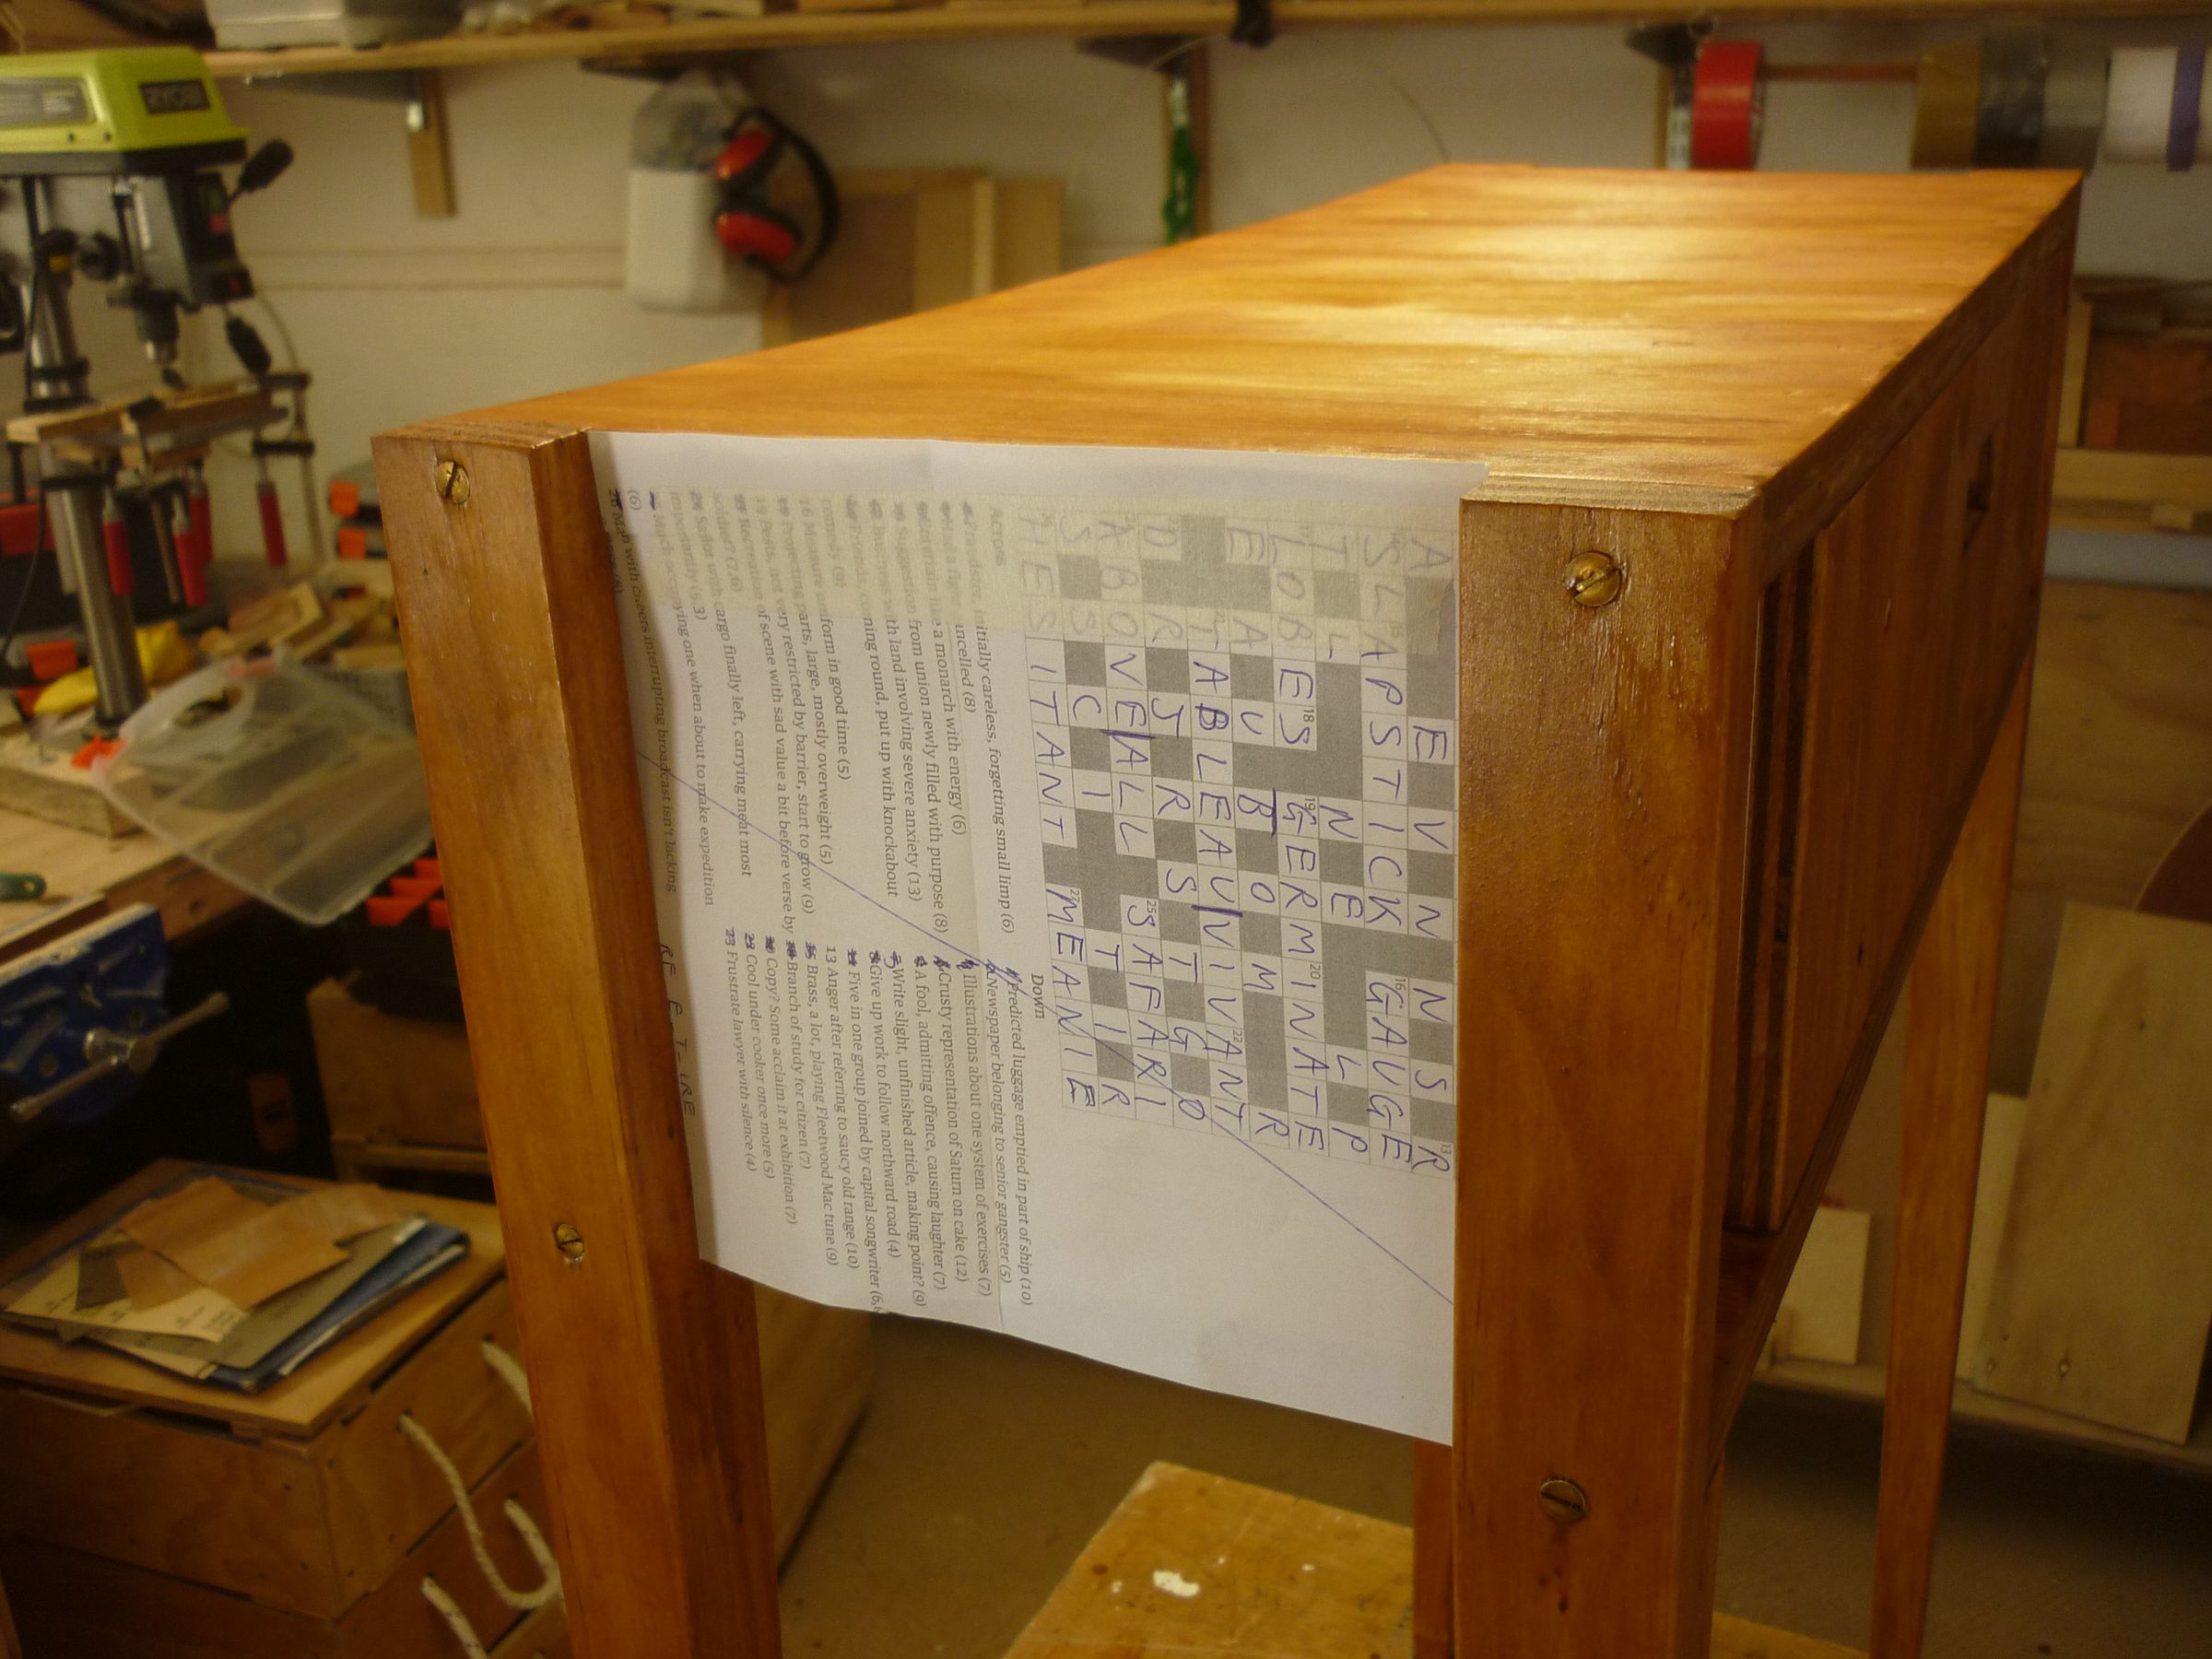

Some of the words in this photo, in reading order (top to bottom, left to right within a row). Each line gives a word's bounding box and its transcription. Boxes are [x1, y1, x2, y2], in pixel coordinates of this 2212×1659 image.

[683, 640, 697, 667] one
[759, 623, 779, 665] scene
[889, 640, 906, 673] land
[909, 619, 925, 656] from
[723, 644, 743, 692] finally
[770, 670, 784, 702] with
[783, 635, 805, 706] restricted
[806, 649, 821, 690] large,
[870, 655, 889, 705] round,
[914, 661, 930, 705] union
[935, 643, 956, 712] monarch
[689, 672, 702, 712] when
[732, 697, 747, 725] left,
[828, 677, 847, 713] good
[962, 692, 976, 712] (8)
[982, 676, 998, 743] careless,
[773, 708, 785, 733] sad
[813, 695, 829, 748] mostly
[876, 711, 891, 737] put
[894, 677, 913, 750] involving
[693, 716, 707, 759] about
[837, 719, 850, 755] time
[923, 711, 938, 759] newly
[946, 718, 960, 751] with
[733, 731, 748, 794] carrying
[776, 737, 788, 780] value
[796, 735, 811, 789] barrier,
[838, 759, 852, 780] (5)
[817, 753, 831, 840] overweight
[882, 767, 895, 801] with
[903, 754, 916, 806] severe
[925, 761, 941, 802] filled
[948, 757, 964, 810] energy
[988, 747, 1006, 825] forgetting
[698, 783, 711, 823] make
[737, 798, 749, 834] meat
[779, 795, 791, 816] bit
[798, 794, 810, 829] start
[780, 820, 795, 868] before
[905, 809, 921, 868] anxiety
[928, 807, 943, 842] with
[951, 815, 967, 835] (6)
[663, 841, 677, 892] lacking
[700, 827, 716, 905] expedition
[740, 841, 753, 877] most
[818, 844, 833, 865] (5)
[884, 806, 900, 897] knockabout
[995, 829, 1010, 870] small
[798, 853, 814, 890] grow
[907, 872, 923, 901] (13)
[928, 847, 946, 909] purpose
[998, 875, 1012, 909] limp
[782, 873, 794, 912] verse
[801, 894, 815, 913] (9)
[933, 913, 948, 933] (8)
[1001, 913, 1015, 934] (6)
[747, 954, 759, 986] Cool
[826, 946, 837, 963] 13
[727, 950, 742, 1016] Frustrate
[765, 958, 780, 1002] Copy?
[787, 960, 800, 1012] Branch
[806, 964, 818, 1007] Brass,
[827, 967, 840, 1011] Anger
[848, 971, 860, 1002] Five
[870, 965, 883, 997] Give
[891, 968, 906, 1007] Write
[937, 971, 952, 1020] Crusty
[1031, 973, 1045, 1018] Down
[748, 990, 761, 1032] under
[915, 985, 929, 1017] fool,
[964, 973, 980, 1062] Illustrations
[986, 977, 1002, 1059] Newspaper
[1007, 982, 1025, 1050] Predicted
[732, 1019, 747, 1066] lawyer
[770, 1005, 782, 1045] Some
[811, 1023, 823, 1047] lot,
[831, 1014, 843, 1048] after
[853, 1024, 864, 1051] one
[875, 1024, 888, 1060] work
[895, 1011, 910, 1054] slight,
[751, 1036, 766, 1084] cooker
[791, 1033, 806, 1073] study
[919, 1021, 935, 1092] admitting
[739, 1069, 751, 1100] with
[772, 1048, 787, 1100] acclaim
[795, 1077, 806, 1098] for
[810, 1051, 827, 1102] playing
[831, 1052, 847, 1113] referring
[852, 1053, 867, 1096] group
[941, 1024, 959, 1128] representation
[969, 1066, 982, 1107] about
[1011, 1053, 1028, 1111] luggage
[758, 1088, 770, 1119] once
[878, 1082, 892, 1125] follow
[899, 1060, 916, 1135] unfinished
[991, 1062, 1006, 1134] belonging
[741, 1103, 755, 1150] silence
[760, 1122, 771, 1158] more
[795, 1100, 809, 1147] citizen
[855, 1099, 870, 1143] joined
[924, 1095, 936, 1151] offence,
[971, 1112, 983, 1138] one
[745, 1153, 757, 1171] (4)
[799, 1150, 811, 1169] (7)
[816, 1106, 833, 1179] Fleetwood
[839, 1134, 851, 1173] saucy
[903, 1139, 920, 1186] article,
[1014, 1114, 1029, 1175] emptied
[763, 1160, 775, 1179] (5)
[780, 1135, 796, 1203] exhibition
[881, 1129, 897, 1202] northward
[926, 1156, 941, 1208] causing
[949, 1150, 964, 1195] Saturn
[971, 1141, 987, 1190] system
[996, 1155, 1008, 1200] senior
[822, 1182, 834, 1211] Mac
[842, 1177, 854, 1197] old
[861, 1166, 877, 1212] capital
[785, 1206, 797, 1224] (7)
[824, 1214, 837, 1244] tune
[843, 1202, 856, 1239] range
[887, 1206, 900, 1236] road
[907, 1190, 922, 1241] making
[1016, 1194, 1030, 1225] part
[865, 1216, 881, 1288] songwriter
[888, 1240, 902, 1258] (4)
[930, 1212, 947, 1269] laughter
[954, 1220, 967, 1252] cake
[978, 1211, 991, 1274] exercises
[996, 1201, 1010, 1263] gangster
[826, 1248, 839, 1265] (9)
[846, 1242, 859, 1268] (10)
[911, 1244, 924, 1287] point?
[955, 1254, 969, 1282] (12)
[999, 1265, 1012, 1283] (5)
[1019, 1244, 1032, 1275] ship
[912, 1289, 926, 1306] (9)
[934, 1271, 948, 1290] (7)
[979, 1277, 993, 1296] (7)
[1020, 1277, 1032, 1305] (10)
